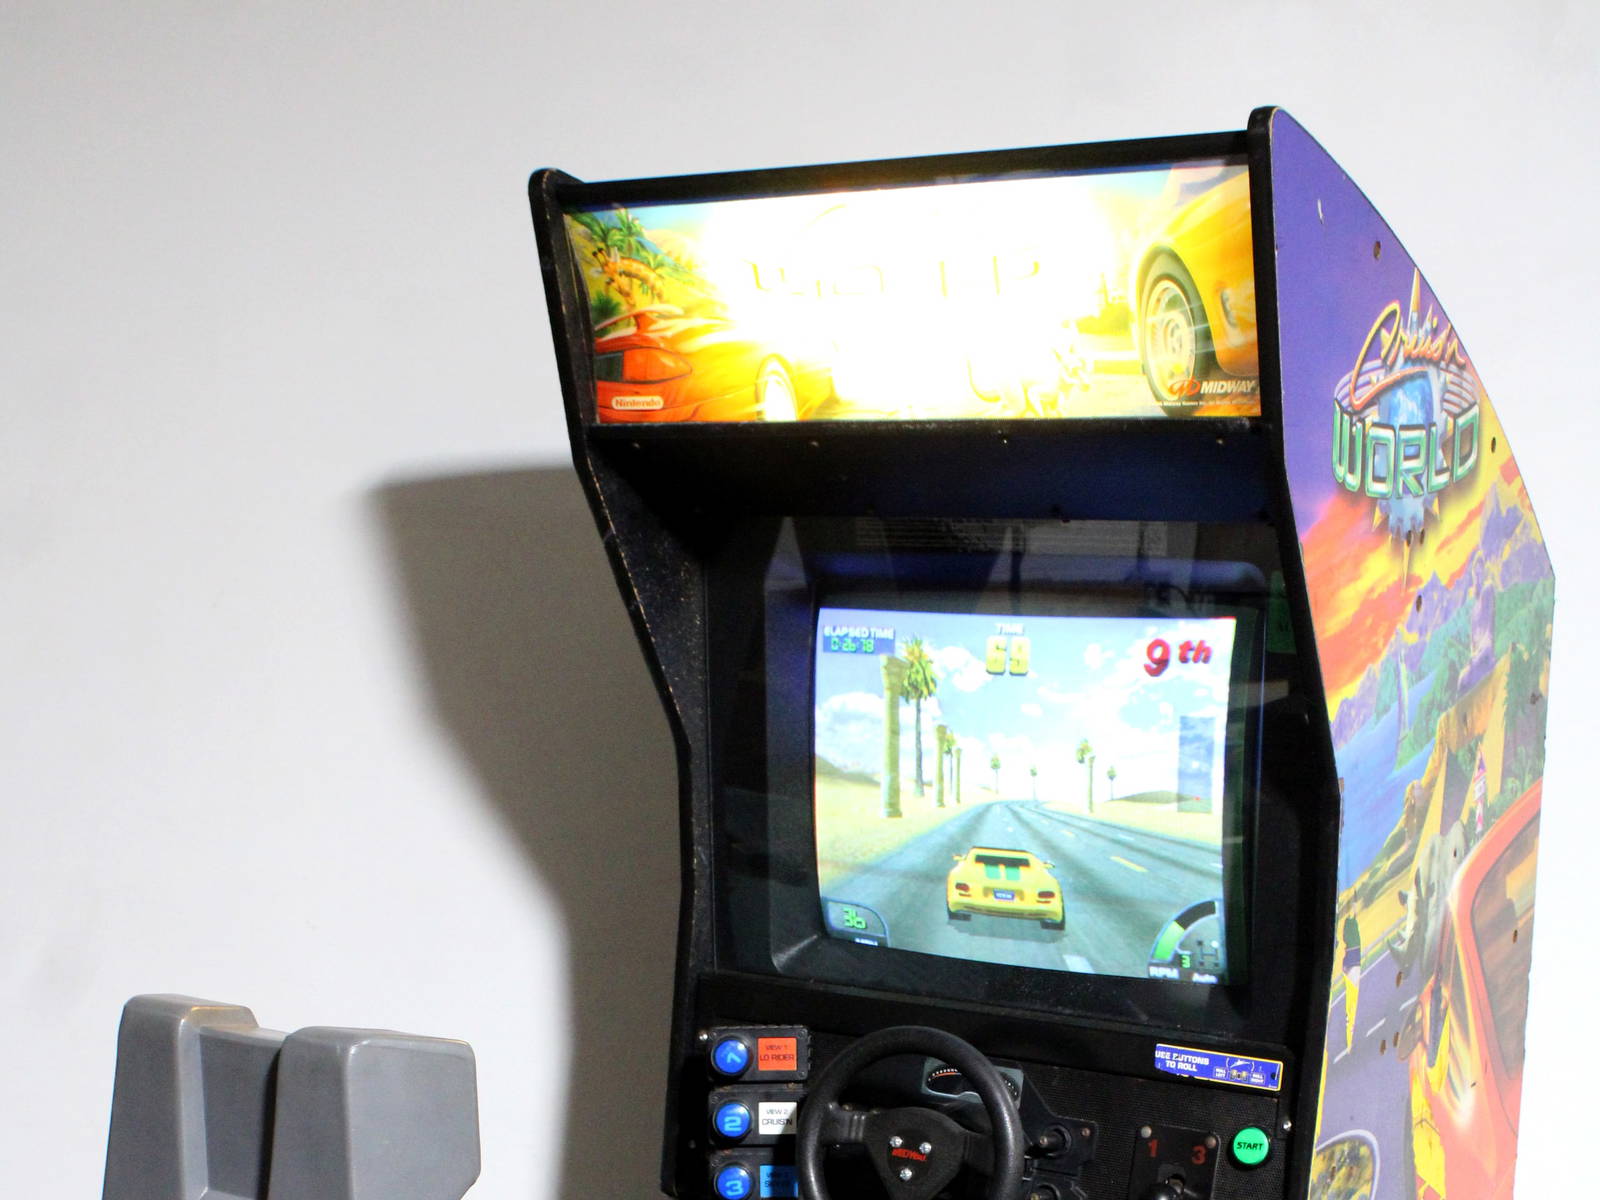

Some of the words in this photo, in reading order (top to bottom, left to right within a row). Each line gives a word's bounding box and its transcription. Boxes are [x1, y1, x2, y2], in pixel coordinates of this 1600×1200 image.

[1200, 380, 1255, 394] MIDWAY
[1332, 398, 1480, 500] WORLD
[1155, 1050, 1171, 1060] USE
[1165, 1060, 1176, 1069] TO
[1177, 1061, 1198, 1072] ROLL
[724, 1116, 742, 1131] 2
[1147, 1138, 1158, 1158] 1
[1191, 1145, 1207, 1165] 3
[1236, 1141, 1264, 1151] START
[726, 1180, 744, 1196] 3
